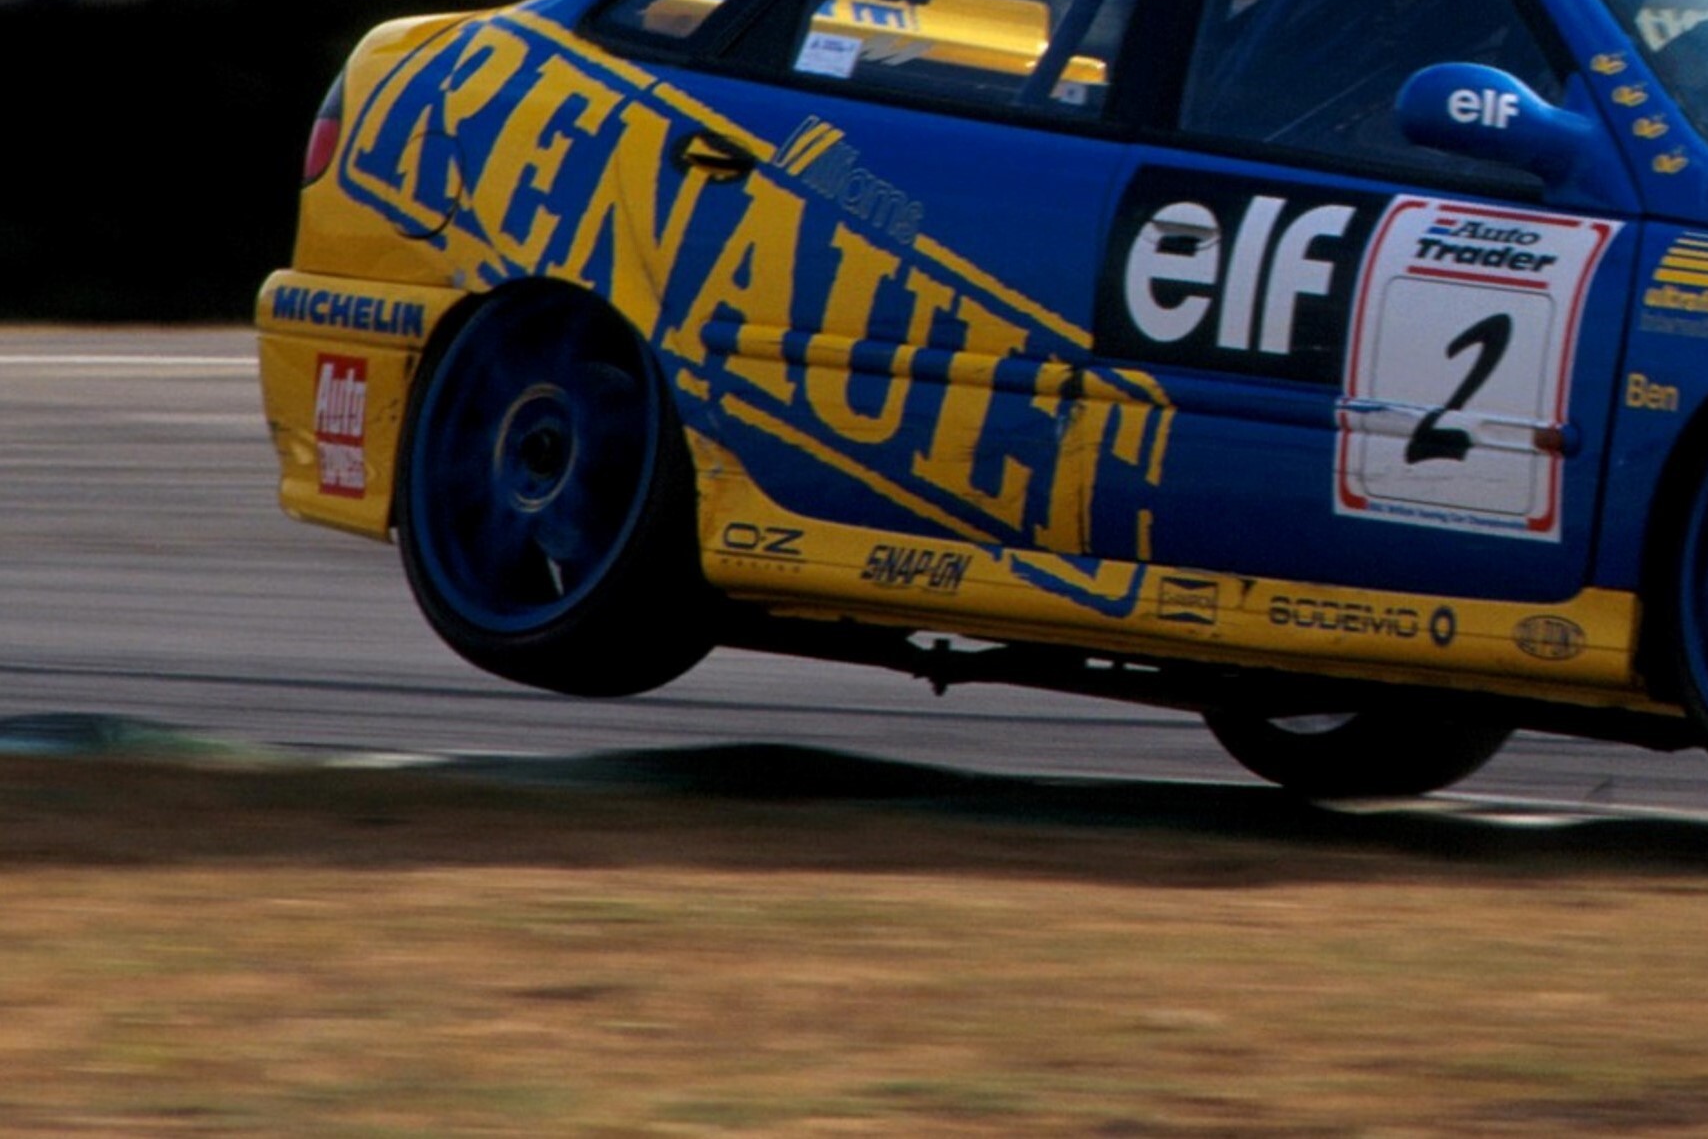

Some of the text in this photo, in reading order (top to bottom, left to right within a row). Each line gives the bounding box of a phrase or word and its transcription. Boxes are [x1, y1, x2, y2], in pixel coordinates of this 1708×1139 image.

[1447, 87, 1520, 129] elf
[1414, 236, 1558, 272] Trader
[1452, 220, 1541, 246] Auto
[356, 19, 1152, 556] RENAULT
[1123, 195, 1356, 355] elf
[272, 284, 425, 335] MICHELIN
[315, 362, 367, 437] Auto
[1404, 312, 1513, 465] 2
[1267, 594, 1419, 639] SODEMO
